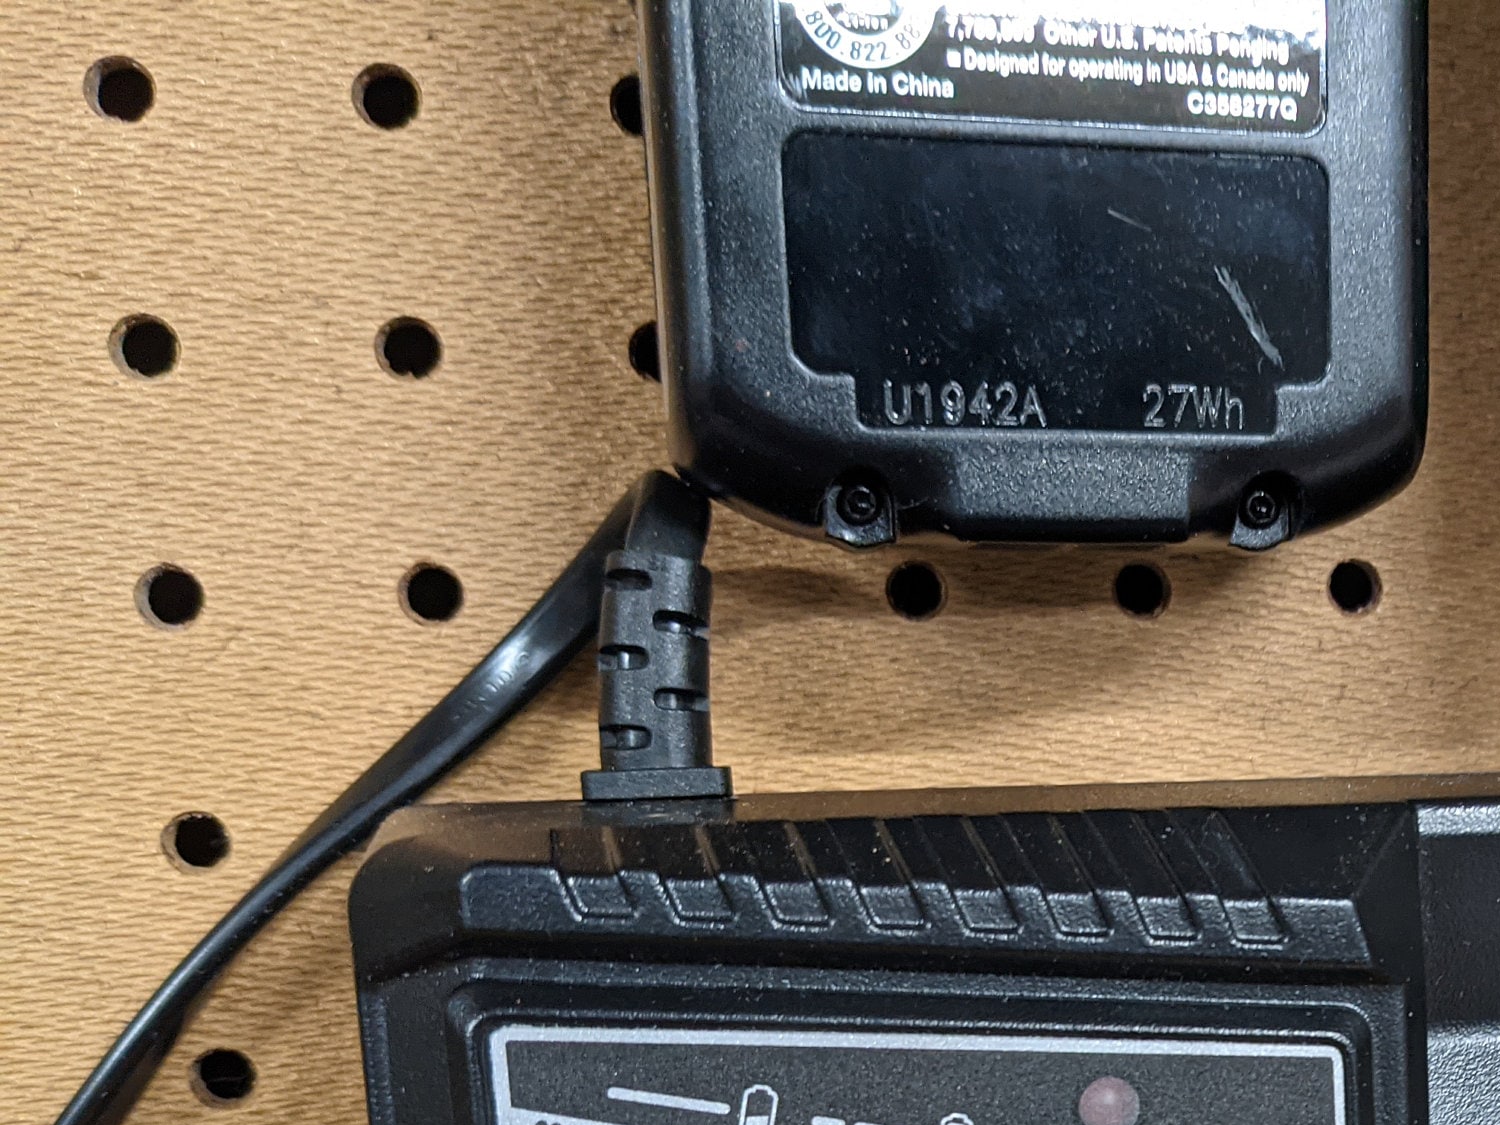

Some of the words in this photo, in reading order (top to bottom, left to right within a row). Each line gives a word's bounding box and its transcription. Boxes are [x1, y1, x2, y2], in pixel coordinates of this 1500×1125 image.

[801, 65, 862, 93] Made
[892, 70, 955, 98] China
[963, 46, 1039, 77] Designed
[1042, 51, 1066, 76] for
[1069, 56, 1143, 86] operating
[1164, 58, 1199, 86] USA
[1216, 62, 1274, 91] Canada
[1278, 66, 1309, 97] only
[883, 379, 1047, 427] U1942A
[1142, 383, 1244, 430] 27Wh
